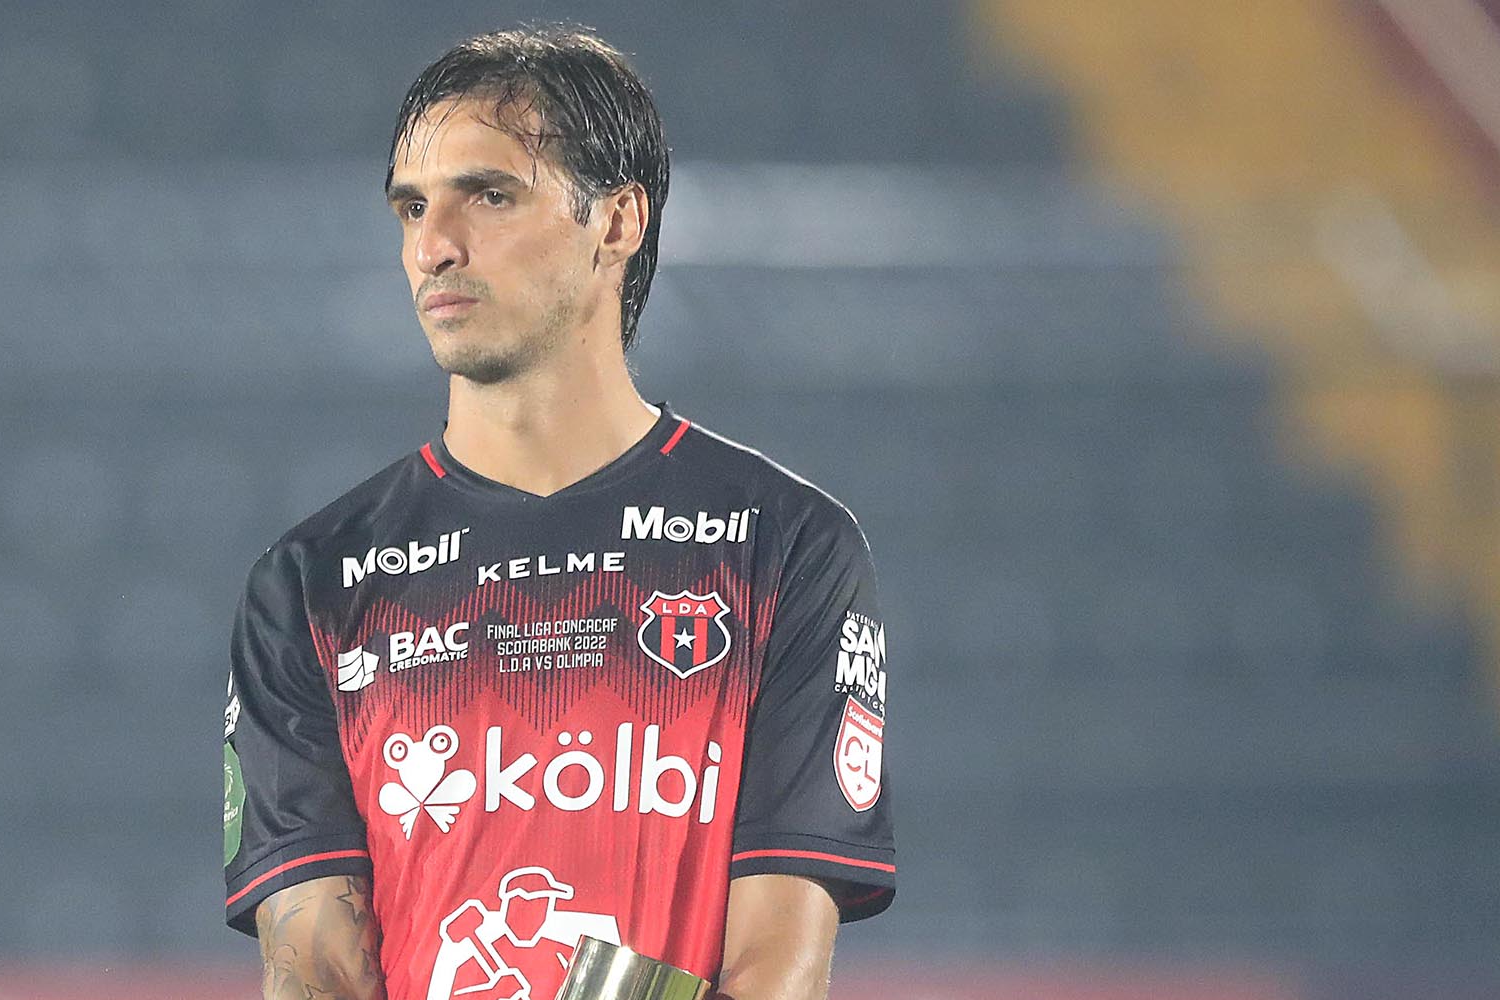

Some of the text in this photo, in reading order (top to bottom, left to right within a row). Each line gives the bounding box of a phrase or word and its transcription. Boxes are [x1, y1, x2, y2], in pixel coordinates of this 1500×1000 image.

[621, 506, 750, 543] Mobil
[342, 531, 460, 588] Mobil
[477, 552, 625, 585] KELME
[662, 602, 708, 615] LDA
[487, 618, 618, 639] FINAL LIGA CONCACAF
[389, 622, 470, 664] BAC
[497, 635, 607, 656] SCOTIABANK 2022
[389, 650, 468, 673] CREDOMATIC
[500, 653, 604, 673] L.D.A VS OLIMPIA
[485, 722, 722, 824] kölbi
